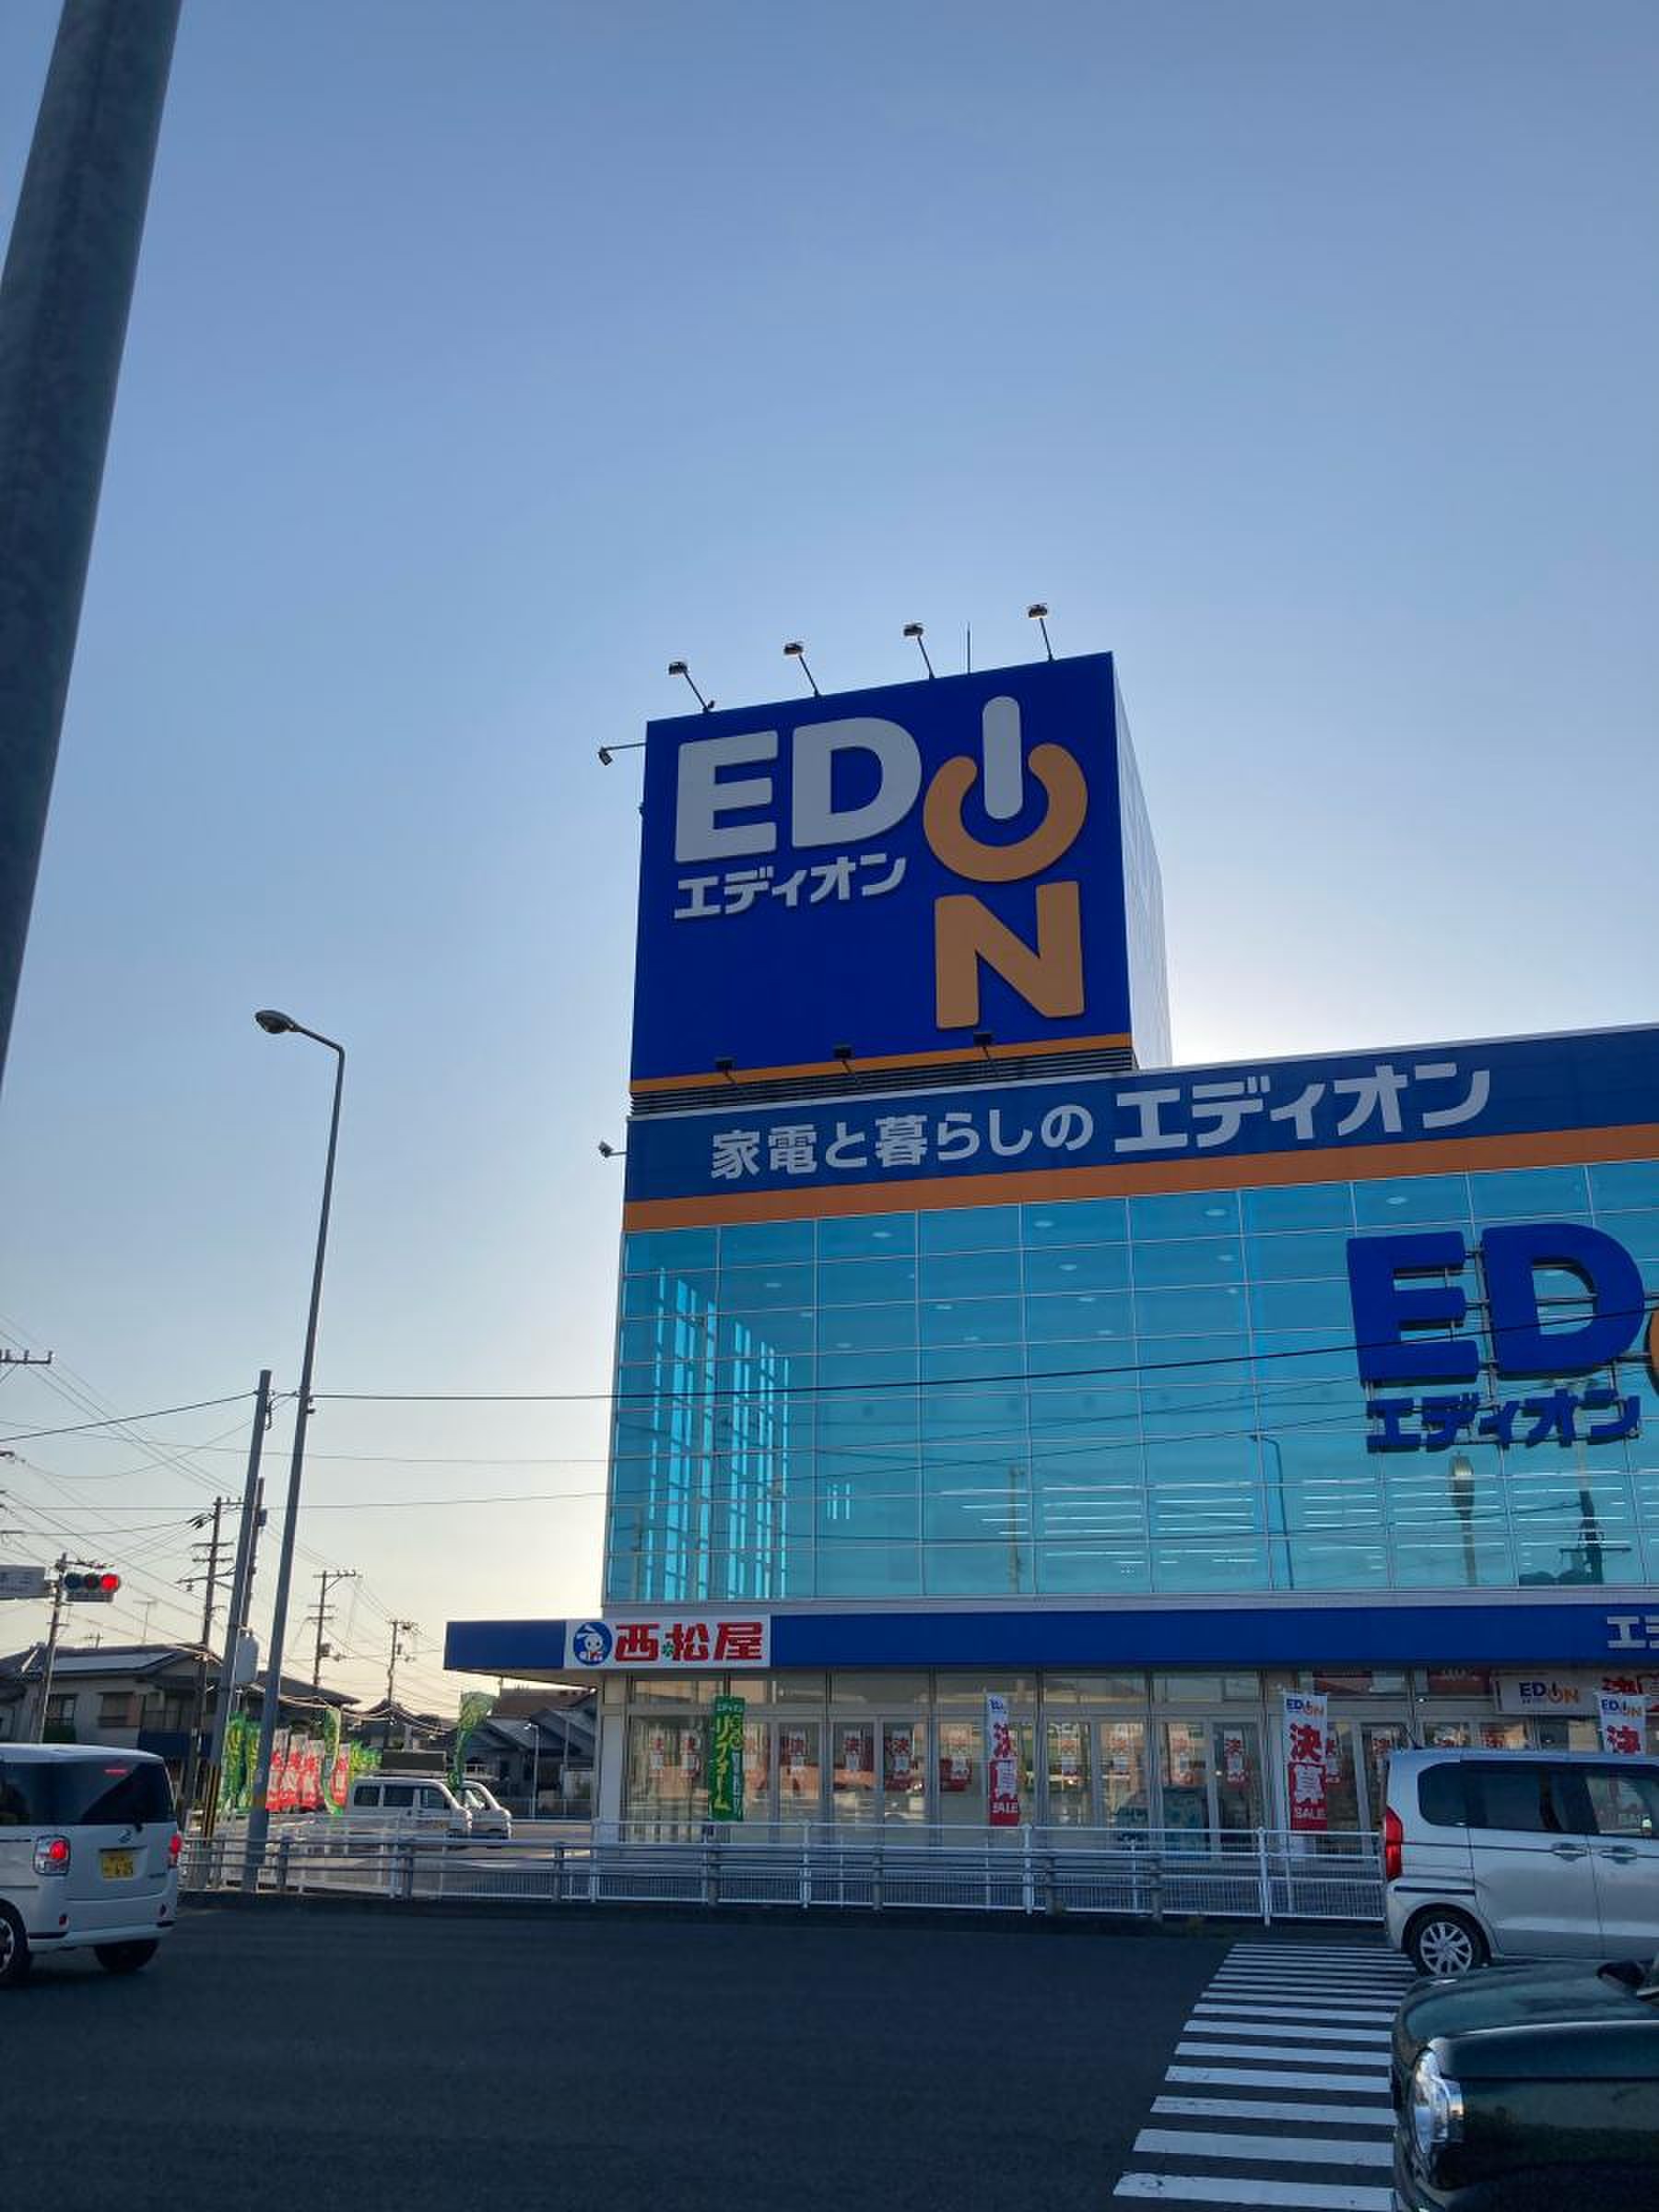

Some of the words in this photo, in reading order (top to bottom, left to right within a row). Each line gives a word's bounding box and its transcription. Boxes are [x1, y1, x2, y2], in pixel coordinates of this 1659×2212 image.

[674, 696, 1088, 1030] EDION
[674, 853, 906, 920] エディオン
[711, 1104, 1094, 1181] 家電と暮らしの
[1114, 1062, 1490, 1153] エディオン
[1347, 1223, 1659, 1387] ED
[1366, 1389, 1641, 1454] エディオン
[615, 1621, 764, 1662] 西松屋
[1519, 1682, 1579, 1703] EDION
